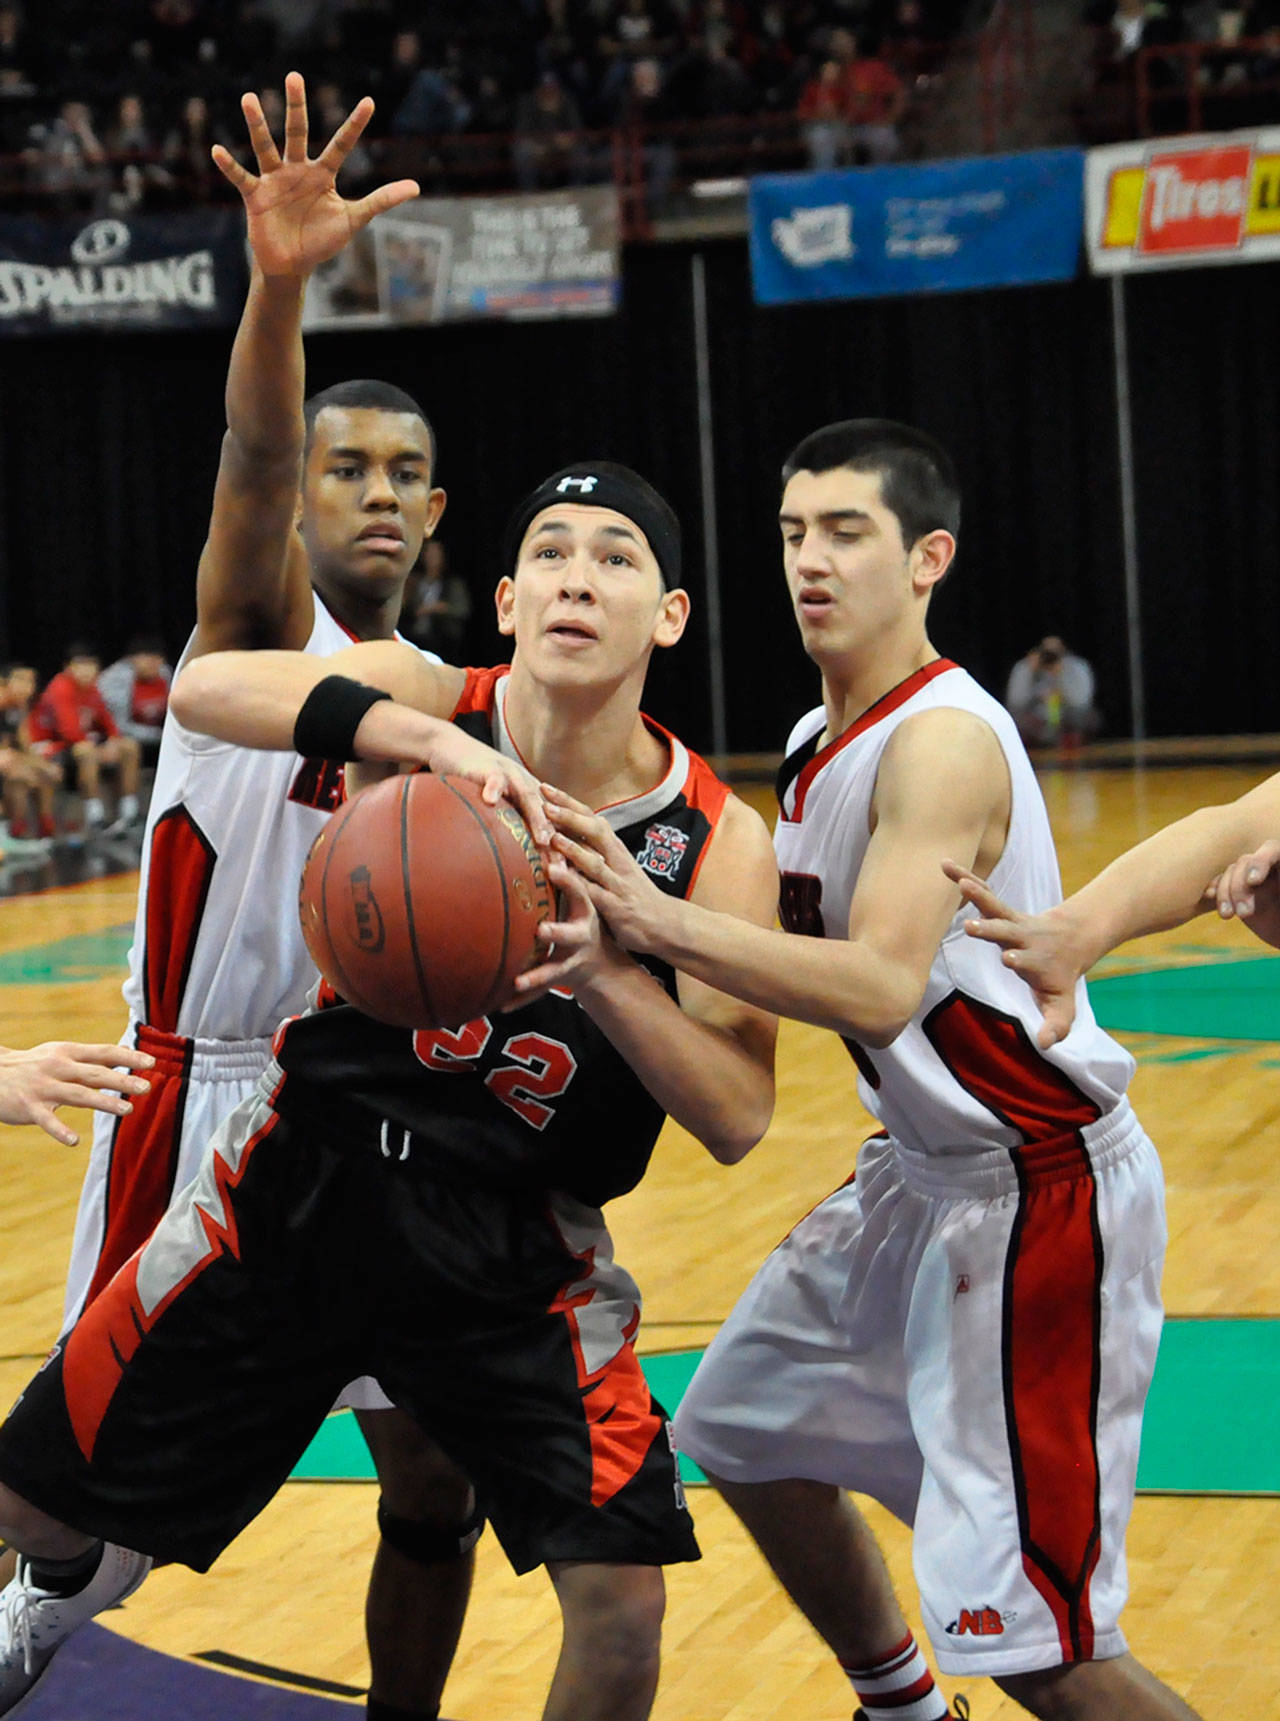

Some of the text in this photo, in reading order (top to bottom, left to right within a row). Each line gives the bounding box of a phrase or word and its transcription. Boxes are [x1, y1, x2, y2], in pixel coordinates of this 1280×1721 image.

[1149, 165, 1242, 231] Tires
[0, 250, 216, 317] SPALDING
[957, 1607, 1004, 1636] NB
